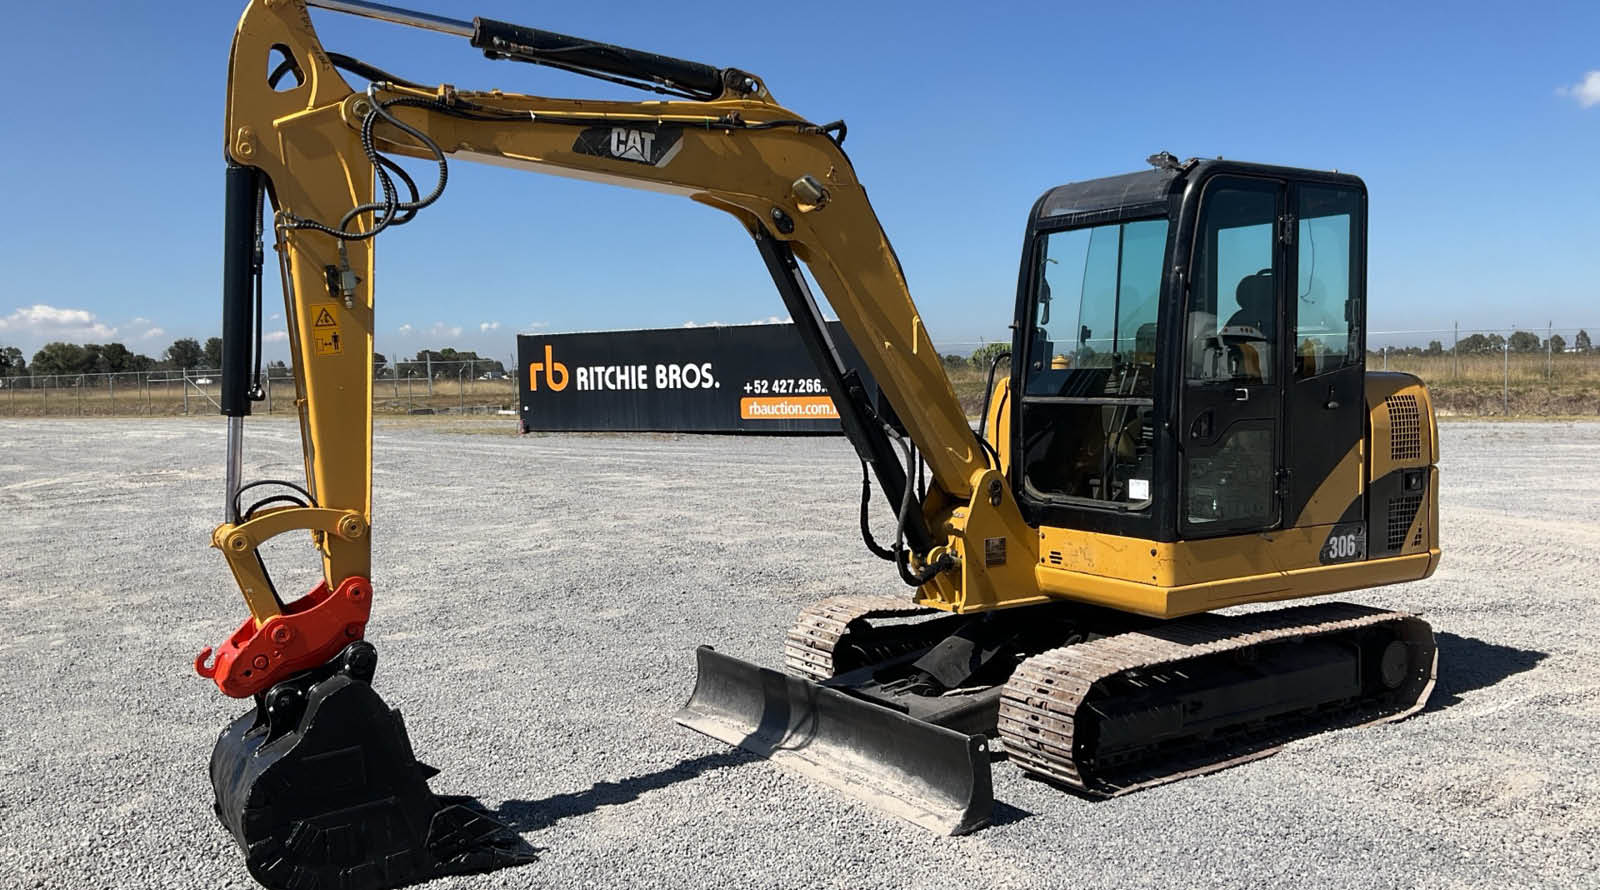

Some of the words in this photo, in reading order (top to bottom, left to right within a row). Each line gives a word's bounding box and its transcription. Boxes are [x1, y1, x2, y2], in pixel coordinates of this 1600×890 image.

[610, 127, 656, 162] CAT
[529, 344, 569, 392] rb
[576, 365, 648, 391] RITCHIE
[655, 362, 721, 389] BROS.
[743, 380, 769, 394] +52
[772, 379, 828, 393] 427.266.
[1329, 534, 1356, 559] 306
